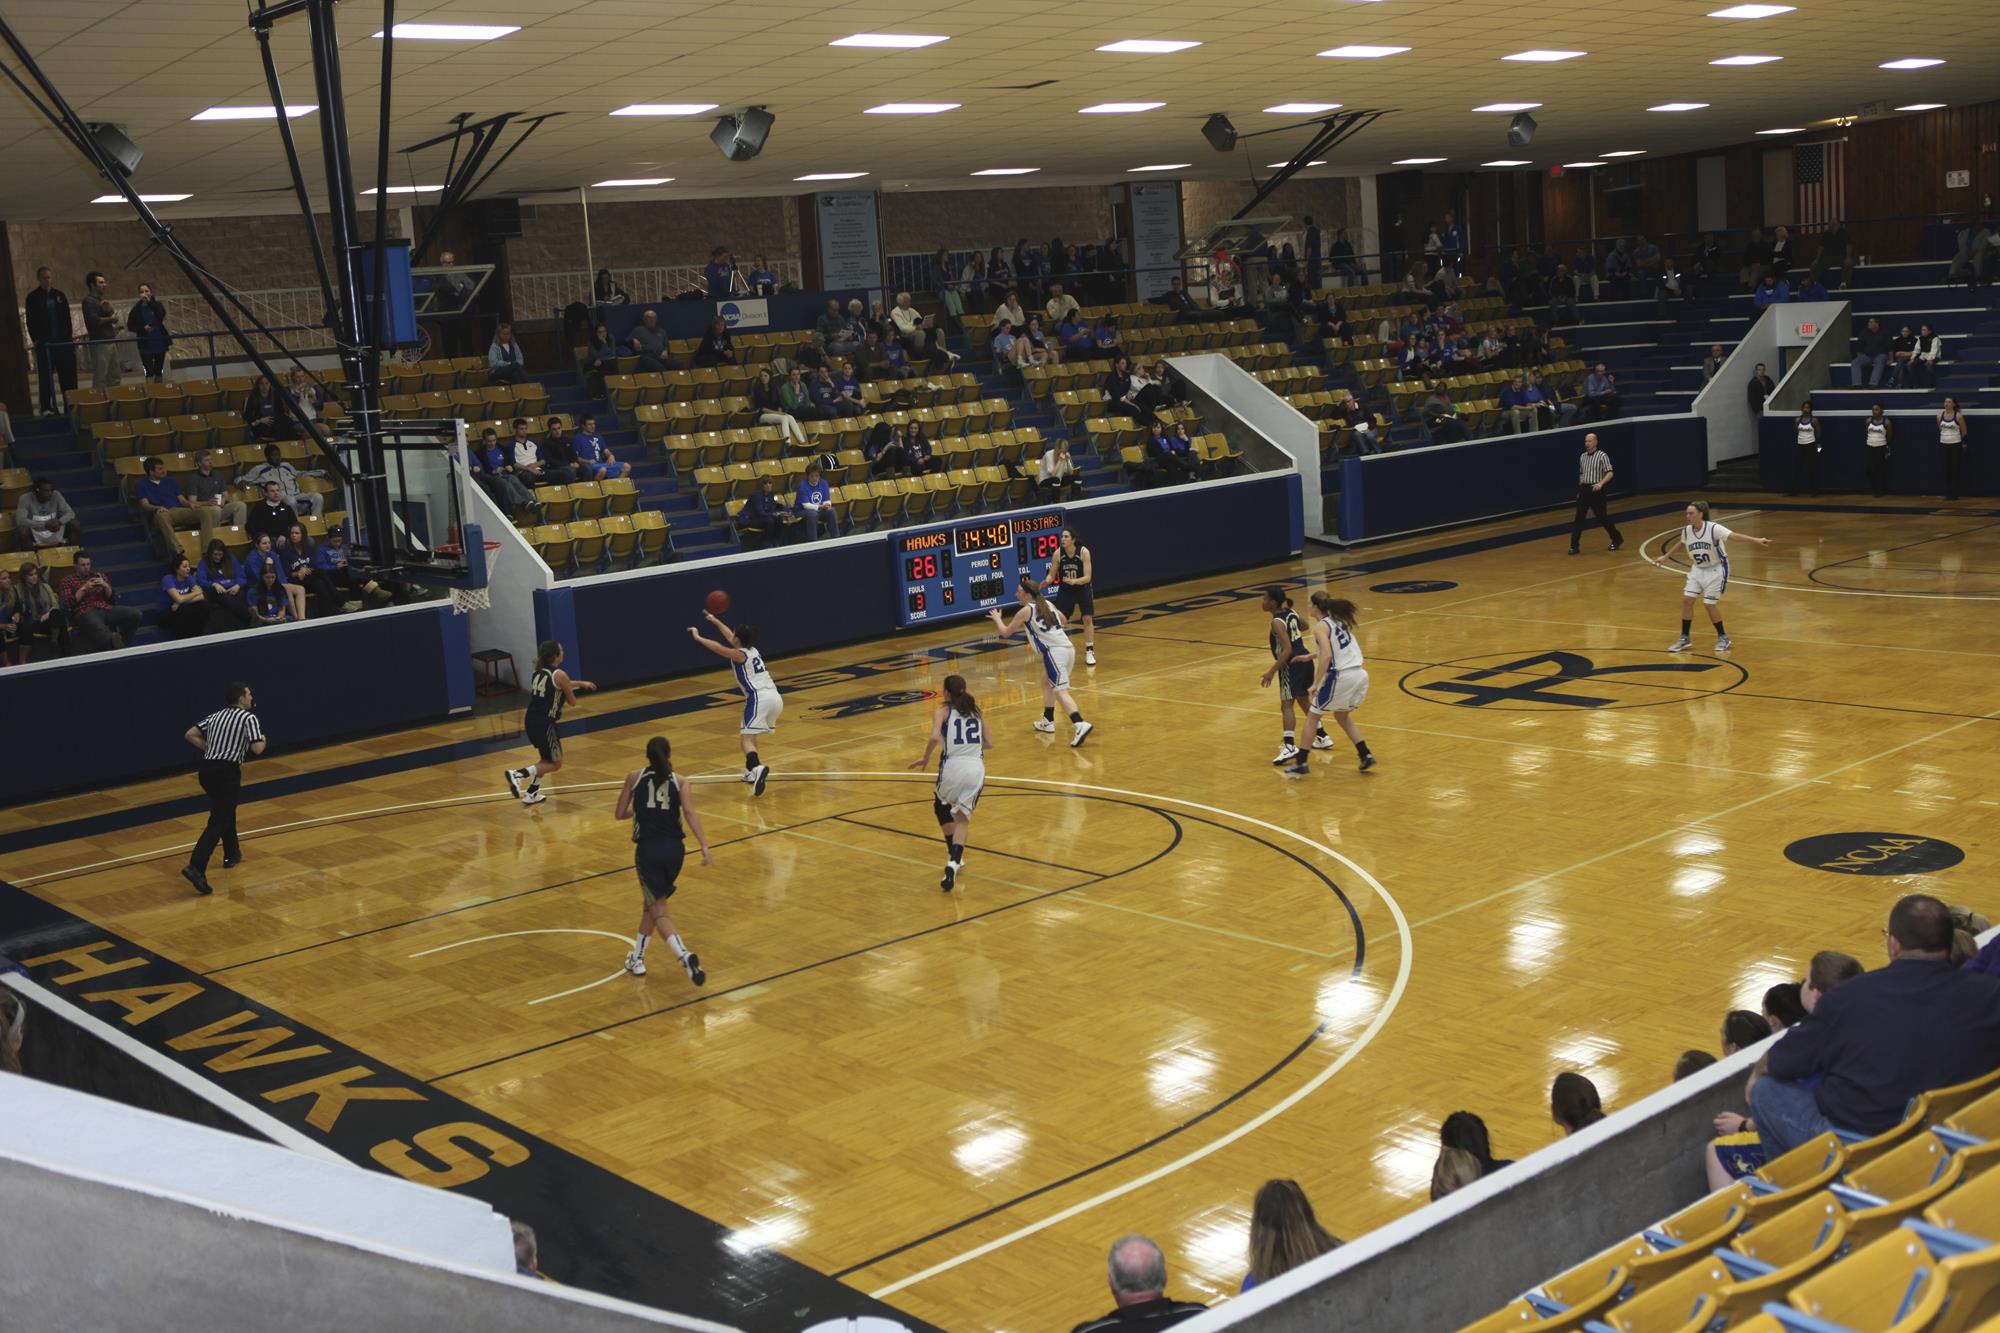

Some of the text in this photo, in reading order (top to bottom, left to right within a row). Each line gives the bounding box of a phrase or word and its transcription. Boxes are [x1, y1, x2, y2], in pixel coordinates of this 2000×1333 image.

[906, 533, 947, 551] HAWKS
[964, 524, 1008, 549] 14:40
[1038, 534, 1058, 559] 29
[971, 559, 989, 569] PERIOD
[991, 553, 999, 568] 2
[1693, 553, 1710, 565] 50
[912, 555, 937, 580] 26
[969, 571, 1004, 583] PLAYER FOUL
[908, 585, 925, 594] FOULS
[944, 590, 953, 602] 4
[916, 594, 925, 609] 3
[980, 597, 997, 607] MATCH
[910, 611, 927, 620] SCORE
[532, 673, 549, 698] 44
[953, 718, 980, 745] 12
[646, 778, 671, 811] 14
[1820, 837, 1929, 873] NCAA
[20, 940, 531, 1189] HAWKS
